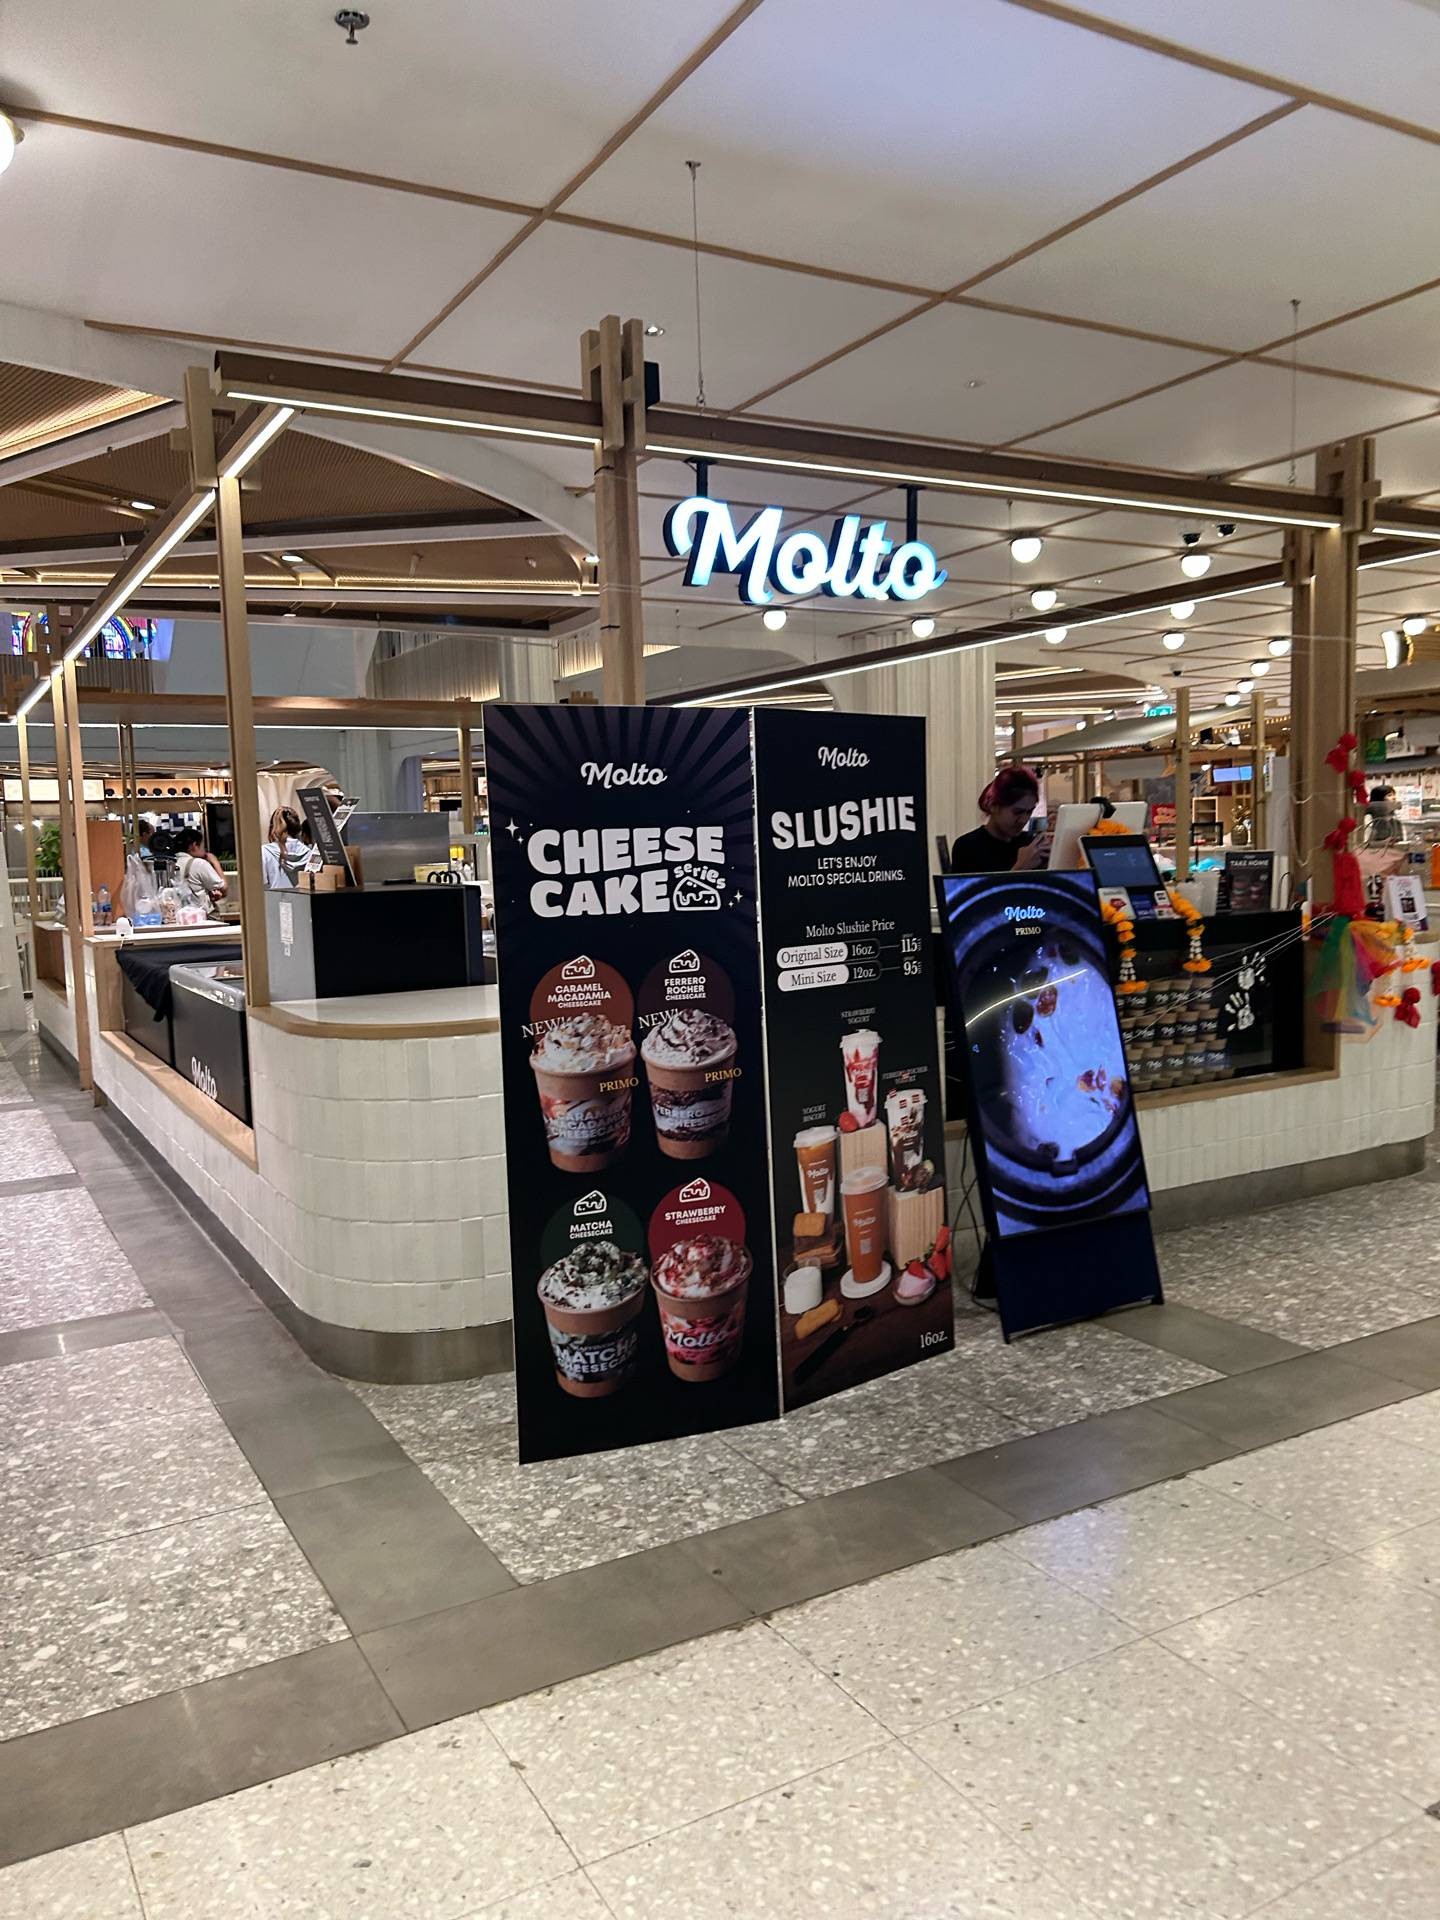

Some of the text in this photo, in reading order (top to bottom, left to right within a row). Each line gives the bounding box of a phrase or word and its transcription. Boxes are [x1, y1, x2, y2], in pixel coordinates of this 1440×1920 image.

[663, 496, 949, 605] Molto
[818, 745, 870, 769] Molto
[580, 761, 668, 789] Molto
[771, 795, 916, 850] SLUSHIE
[527, 826, 725, 875] CHEESE
[817, 855, 877, 870] LET'S ENJOY
[674, 863, 726, 889] series
[788, 869, 906, 888] MOLTO SPECIAL DRINKS.
[530, 869, 670, 918] CAKE
[1004, 905, 1046, 922] Molto
[806, 918, 895, 938] Molto Slushie Price
[1015, 926, 1041, 936] PRIMO
[781, 948, 822, 965] Original
[824, 946, 844, 960] Size
[900, 937, 918, 953] 115
[664, 976, 706, 987] FERRERO
[791, 973, 815, 987] Mini
[818, 970, 837, 983] Size
[903, 961, 918, 976] 95
[547, 991, 612, 1004] MACADAMIA
[555, 983, 603, 995] CARAMEL
[665, 992, 707, 1002] CHEESECAKE
[666, 984, 705, 995] ROCHER
[557, 999, 602, 1009] CHEESECAKE
[191, 1056, 217, 1099] Molto
[704, 1067, 742, 1083] PRIMO
[600, 1076, 639, 1093] PRIMO
[665, 1205, 726, 1221] STRAWBERRY
[675, 1214, 717, 1226] CHEESECAKE
[569, 1228, 613, 1240] CHEESECAKE
[570, 1220, 613, 1234] MATCHA
